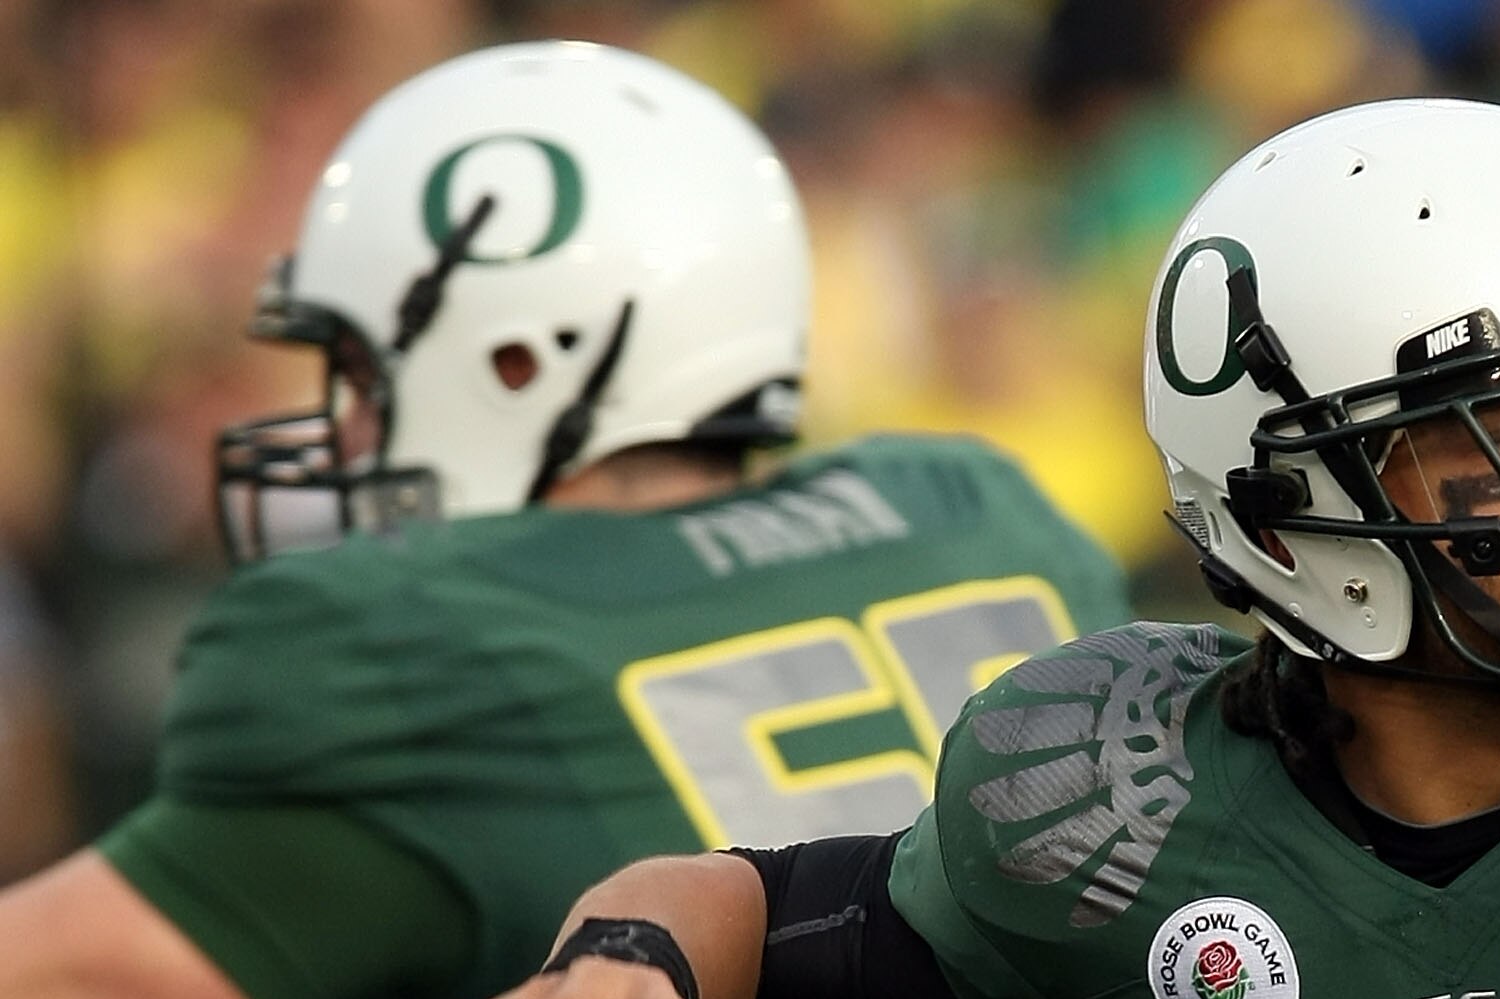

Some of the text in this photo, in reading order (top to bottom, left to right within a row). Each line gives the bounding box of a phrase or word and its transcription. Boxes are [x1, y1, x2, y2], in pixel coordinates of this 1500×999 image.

[423, 134, 585, 264] O
[1426, 318, 1470, 359] NIKE
[1160, 913, 1287, 997] ROSE BOWL GAME
